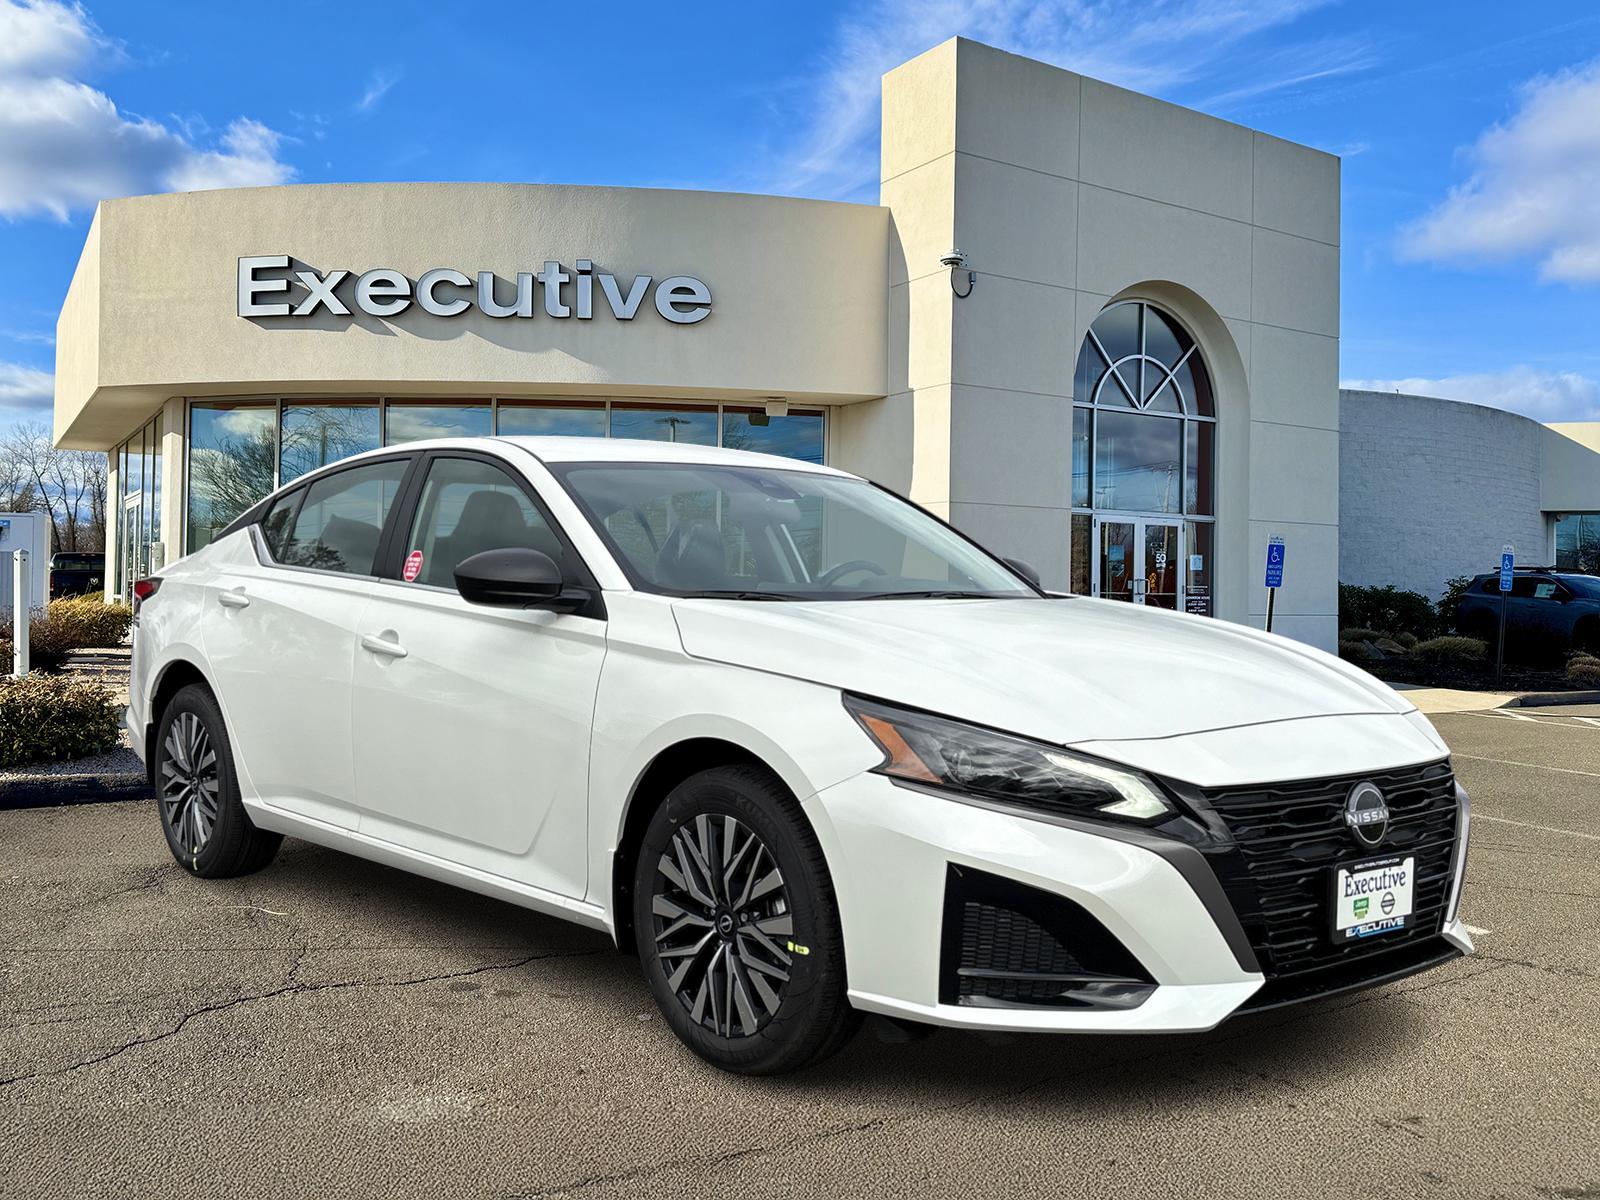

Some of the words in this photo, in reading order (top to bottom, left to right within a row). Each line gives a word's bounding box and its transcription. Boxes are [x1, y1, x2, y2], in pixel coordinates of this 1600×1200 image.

[237, 254, 713, 325] Executive
[1347, 809, 1389, 824] NISSAN
[1344, 867, 1406, 898] Executive
[1345, 916, 1405, 937] EXECUTIVE
